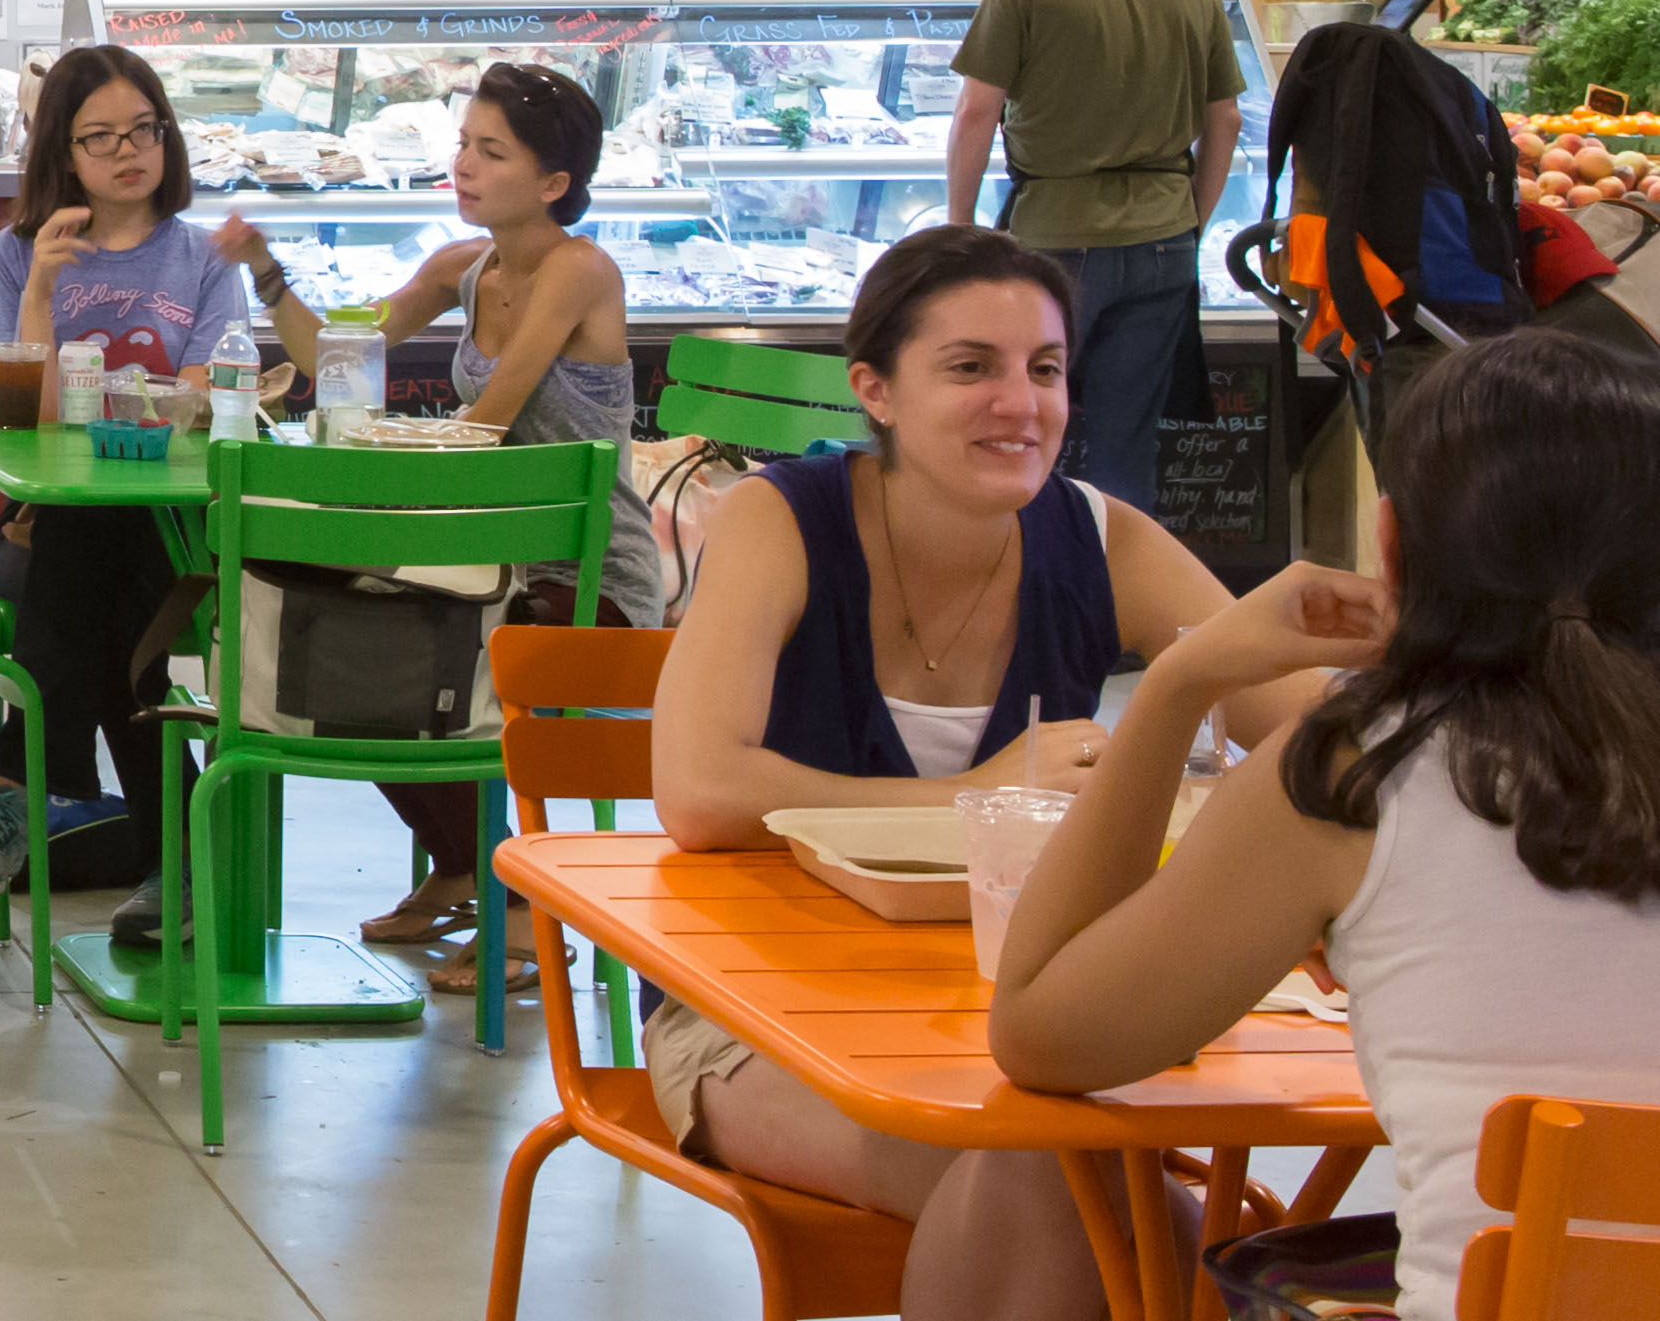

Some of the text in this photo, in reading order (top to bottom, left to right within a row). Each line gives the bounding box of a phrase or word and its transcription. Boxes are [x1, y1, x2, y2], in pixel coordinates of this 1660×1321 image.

[109, 10, 186, 34] RAISED
[275, 10, 394, 40] SMOKED
[440, 12, 545, 36] GRINDS
[699, 15, 803, 44] GRASS
[817, 14, 862, 40] FED
[61, 283, 146, 320] Rolling
[385, 378, 453, 402] EATS
